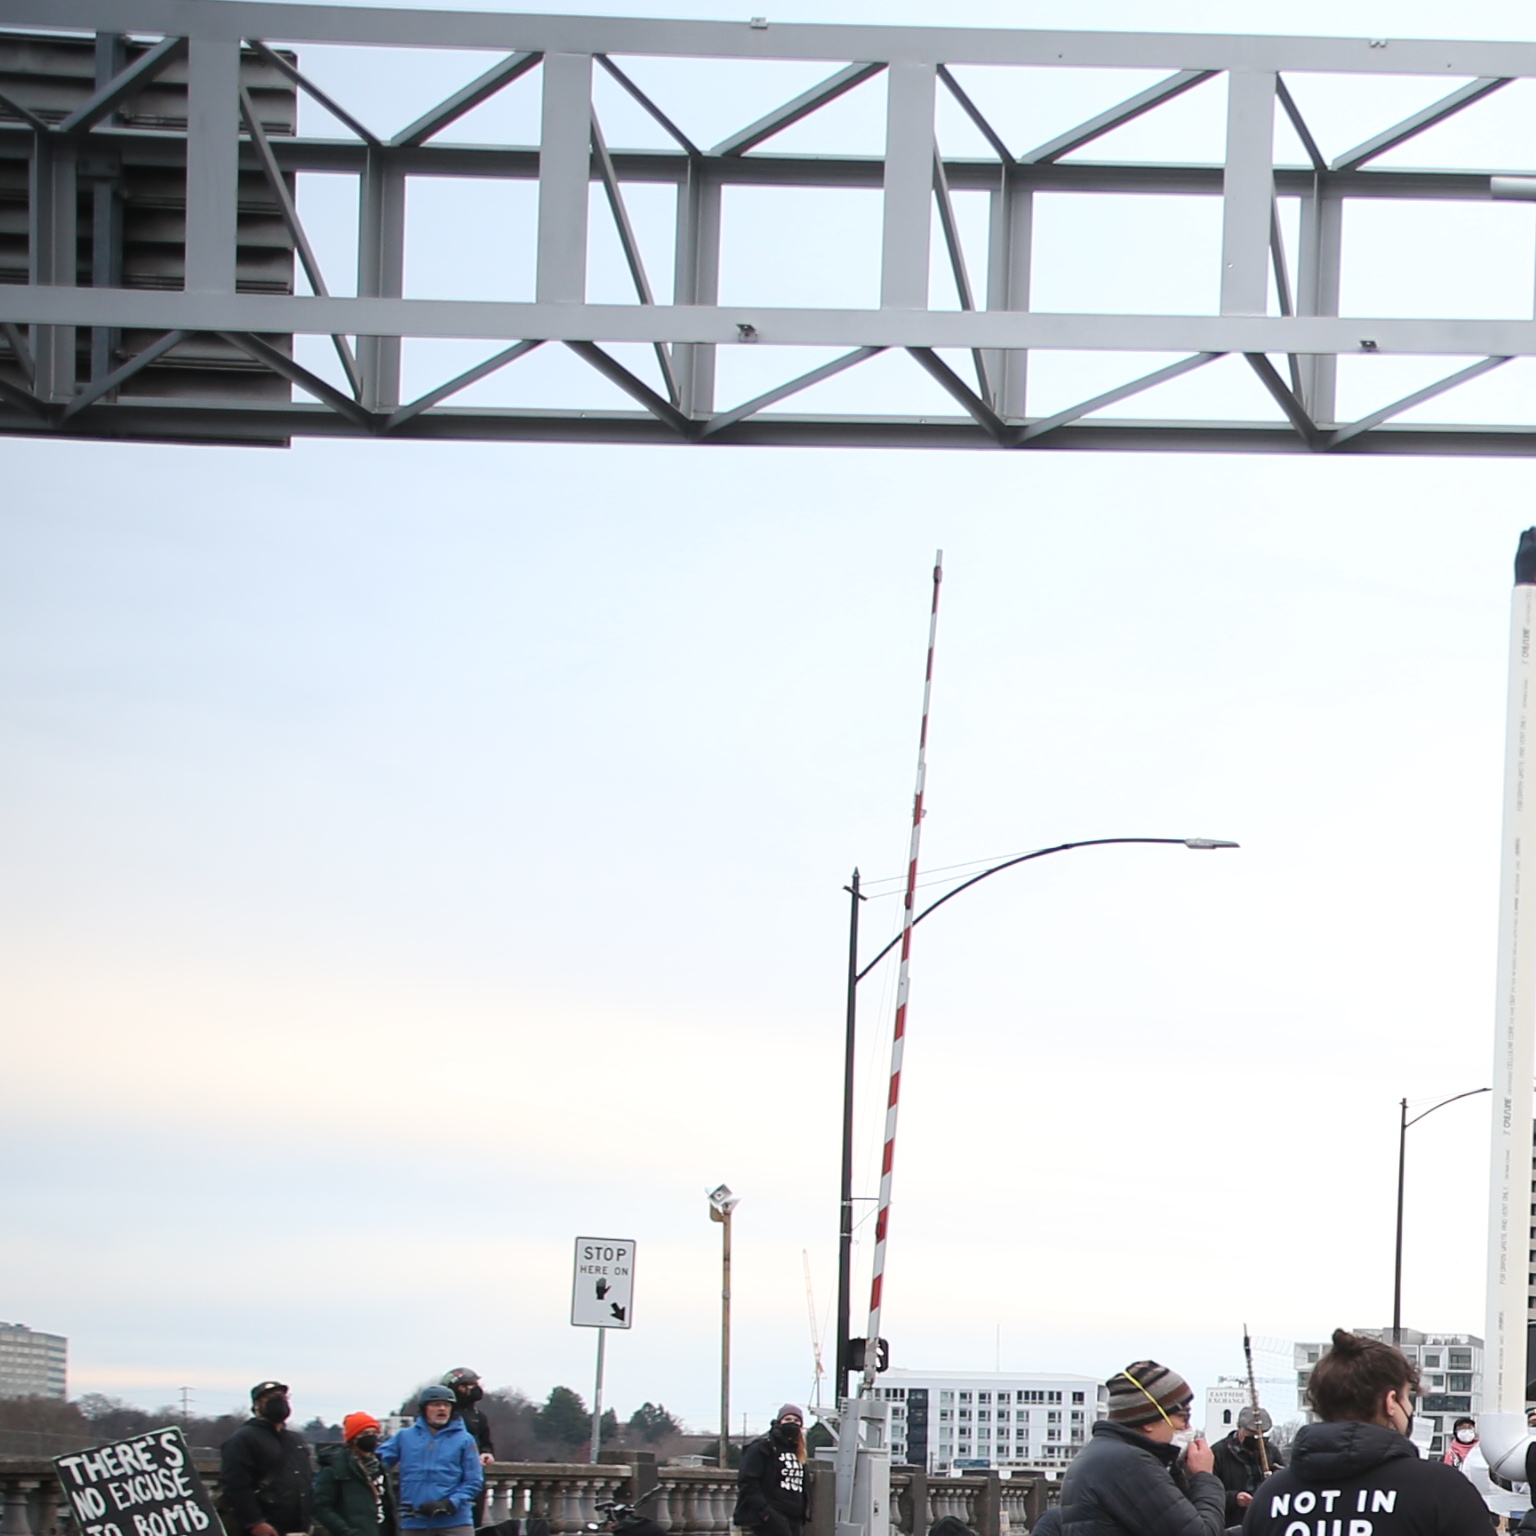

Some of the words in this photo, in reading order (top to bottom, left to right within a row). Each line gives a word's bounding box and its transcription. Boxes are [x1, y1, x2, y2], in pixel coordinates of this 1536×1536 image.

[584, 1246, 627, 1261] STOP
[580, 1265, 608, 1275] HERE
[614, 1266, 629, 1276] ON
[58, 1432, 184, 1486] THERE'S
[71, 1490, 106, 1522] NO
[109, 1467, 194, 1511] EXCUSE
[1270, 1489, 1342, 1519] NOT
[1356, 1489, 1397, 1514] IN
